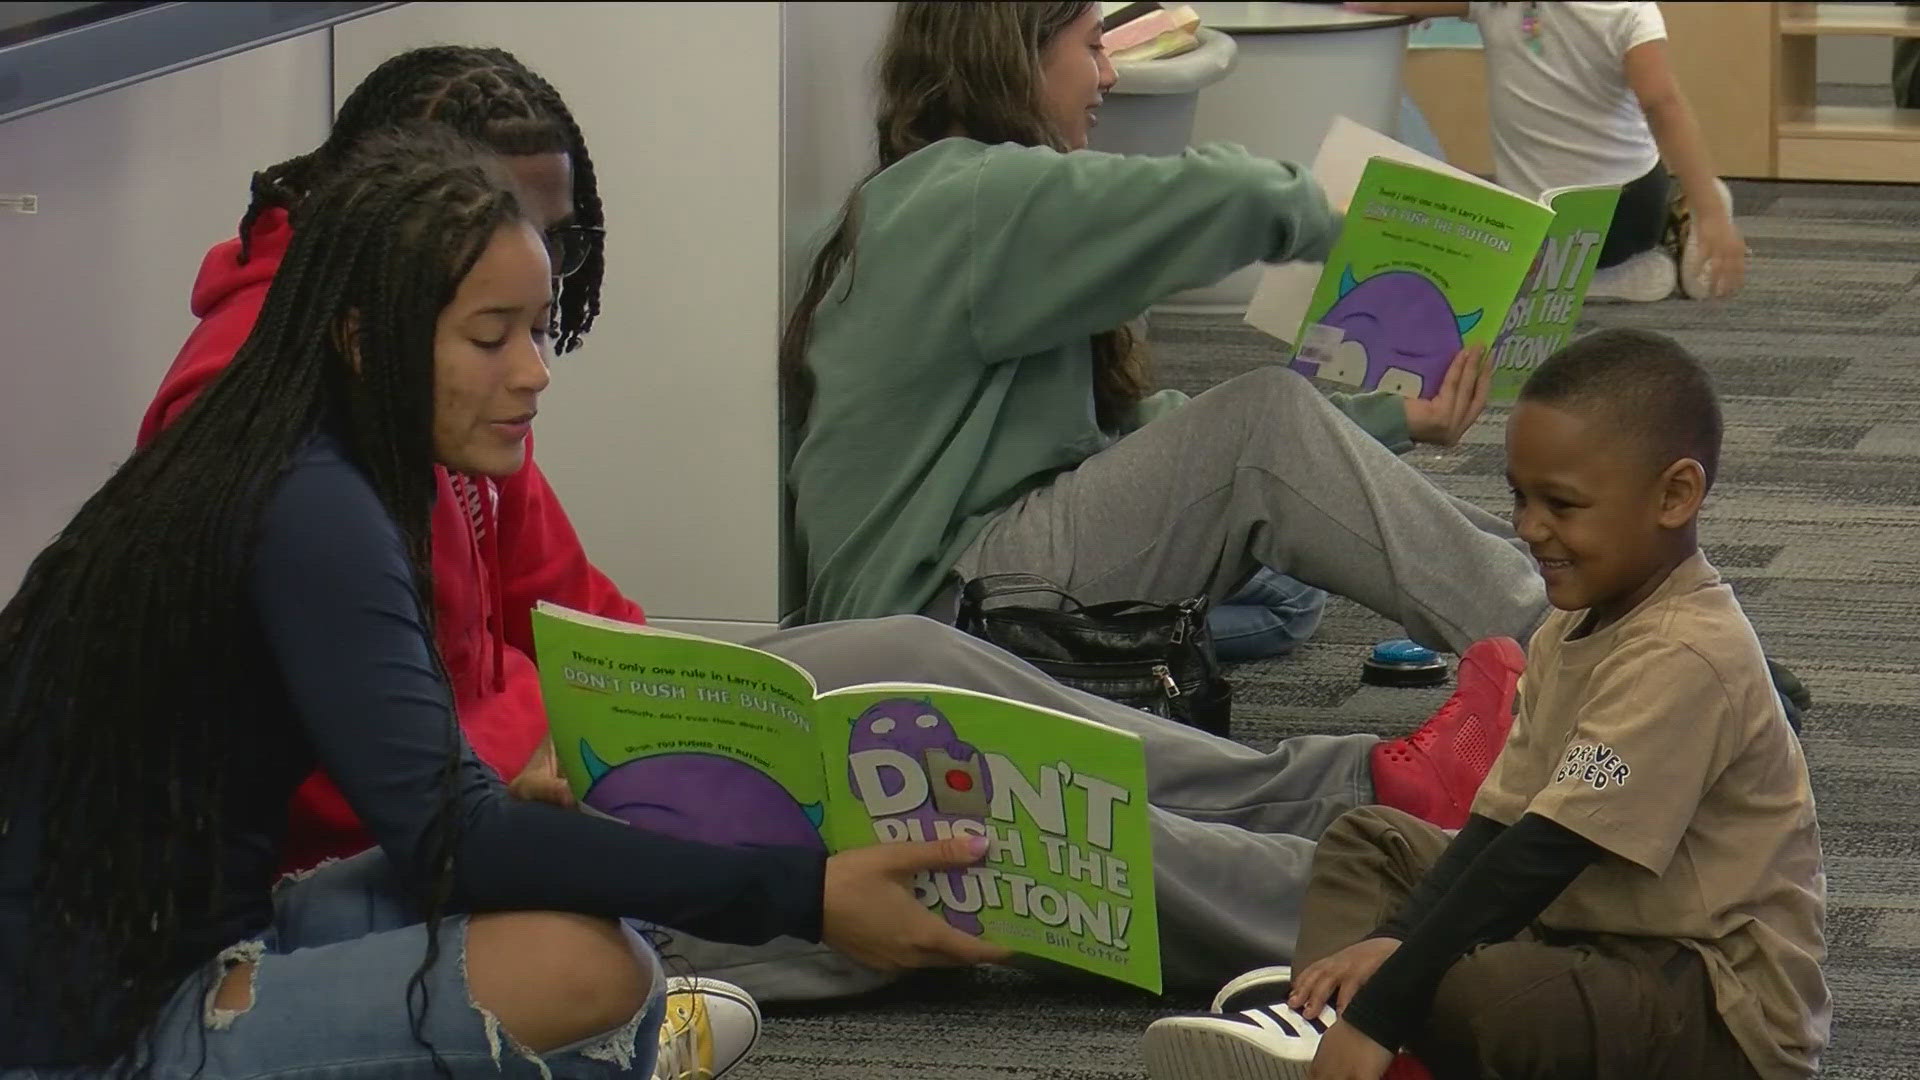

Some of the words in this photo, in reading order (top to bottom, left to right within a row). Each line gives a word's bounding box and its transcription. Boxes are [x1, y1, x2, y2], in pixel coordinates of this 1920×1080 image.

[564, 667, 622, 692] DON'T
[629, 681, 686, 699] PUSH
[697, 688, 731, 703] THE
[572, 650, 613, 669] There's
[618, 663, 646, 674] only
[652, 667, 676, 676] one
[680, 668, 706, 679] rule
[711, 671, 723, 681] in
[727, 674, 767, 691] Larry's
[1038, 834, 1133, 899] THE
[1045, 931, 1071, 949] Bill
[1077, 942, 1129, 966] Cotter
